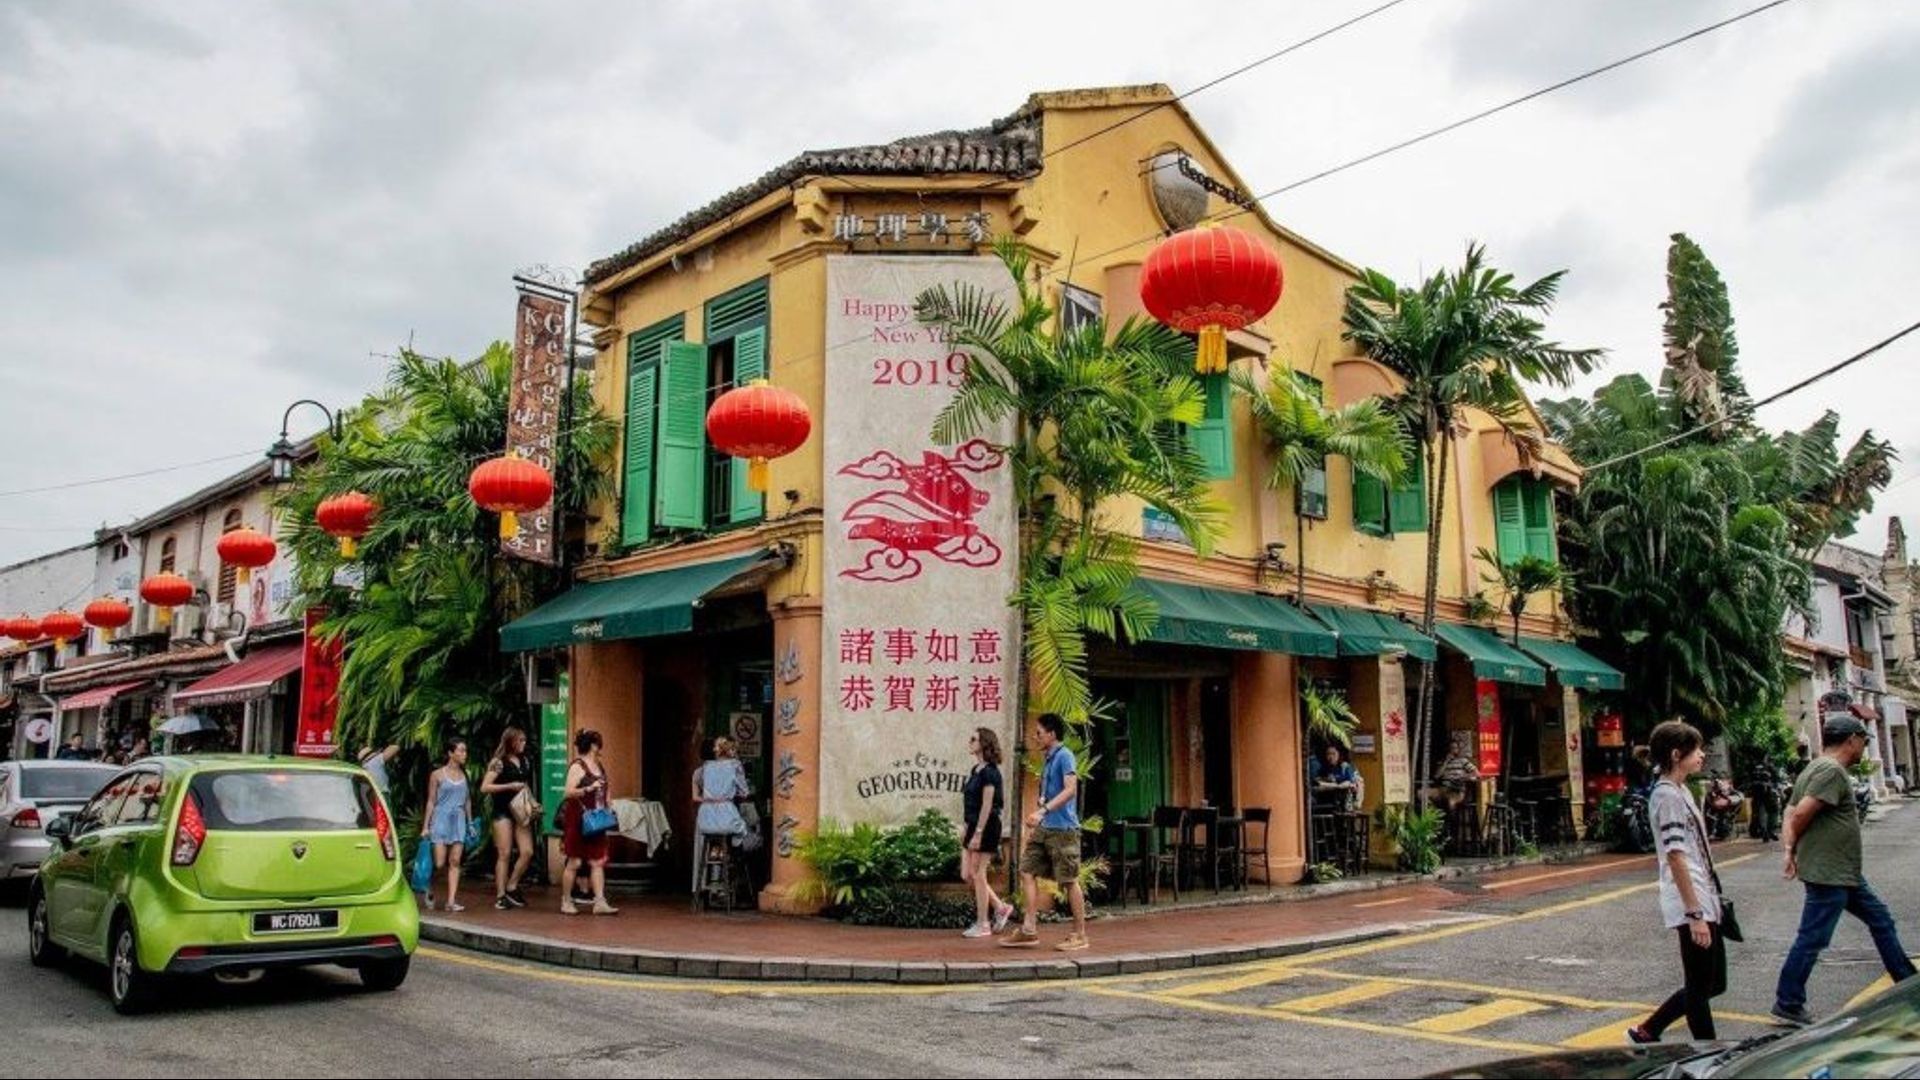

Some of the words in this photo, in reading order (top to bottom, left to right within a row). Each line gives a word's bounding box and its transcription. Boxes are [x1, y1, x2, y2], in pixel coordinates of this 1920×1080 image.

[842, 298, 911, 322] Happy
[521, 308, 539, 392] Kafe
[871, 327, 919, 343] New
[872, 352, 970, 388] 2019
[534, 312, 563, 554] Geograper
[840, 628, 1003, 665] 諸事如意
[840, 675, 1003, 712] 恭賀新禧
[857, 771, 967, 799] GEOGRAPH
